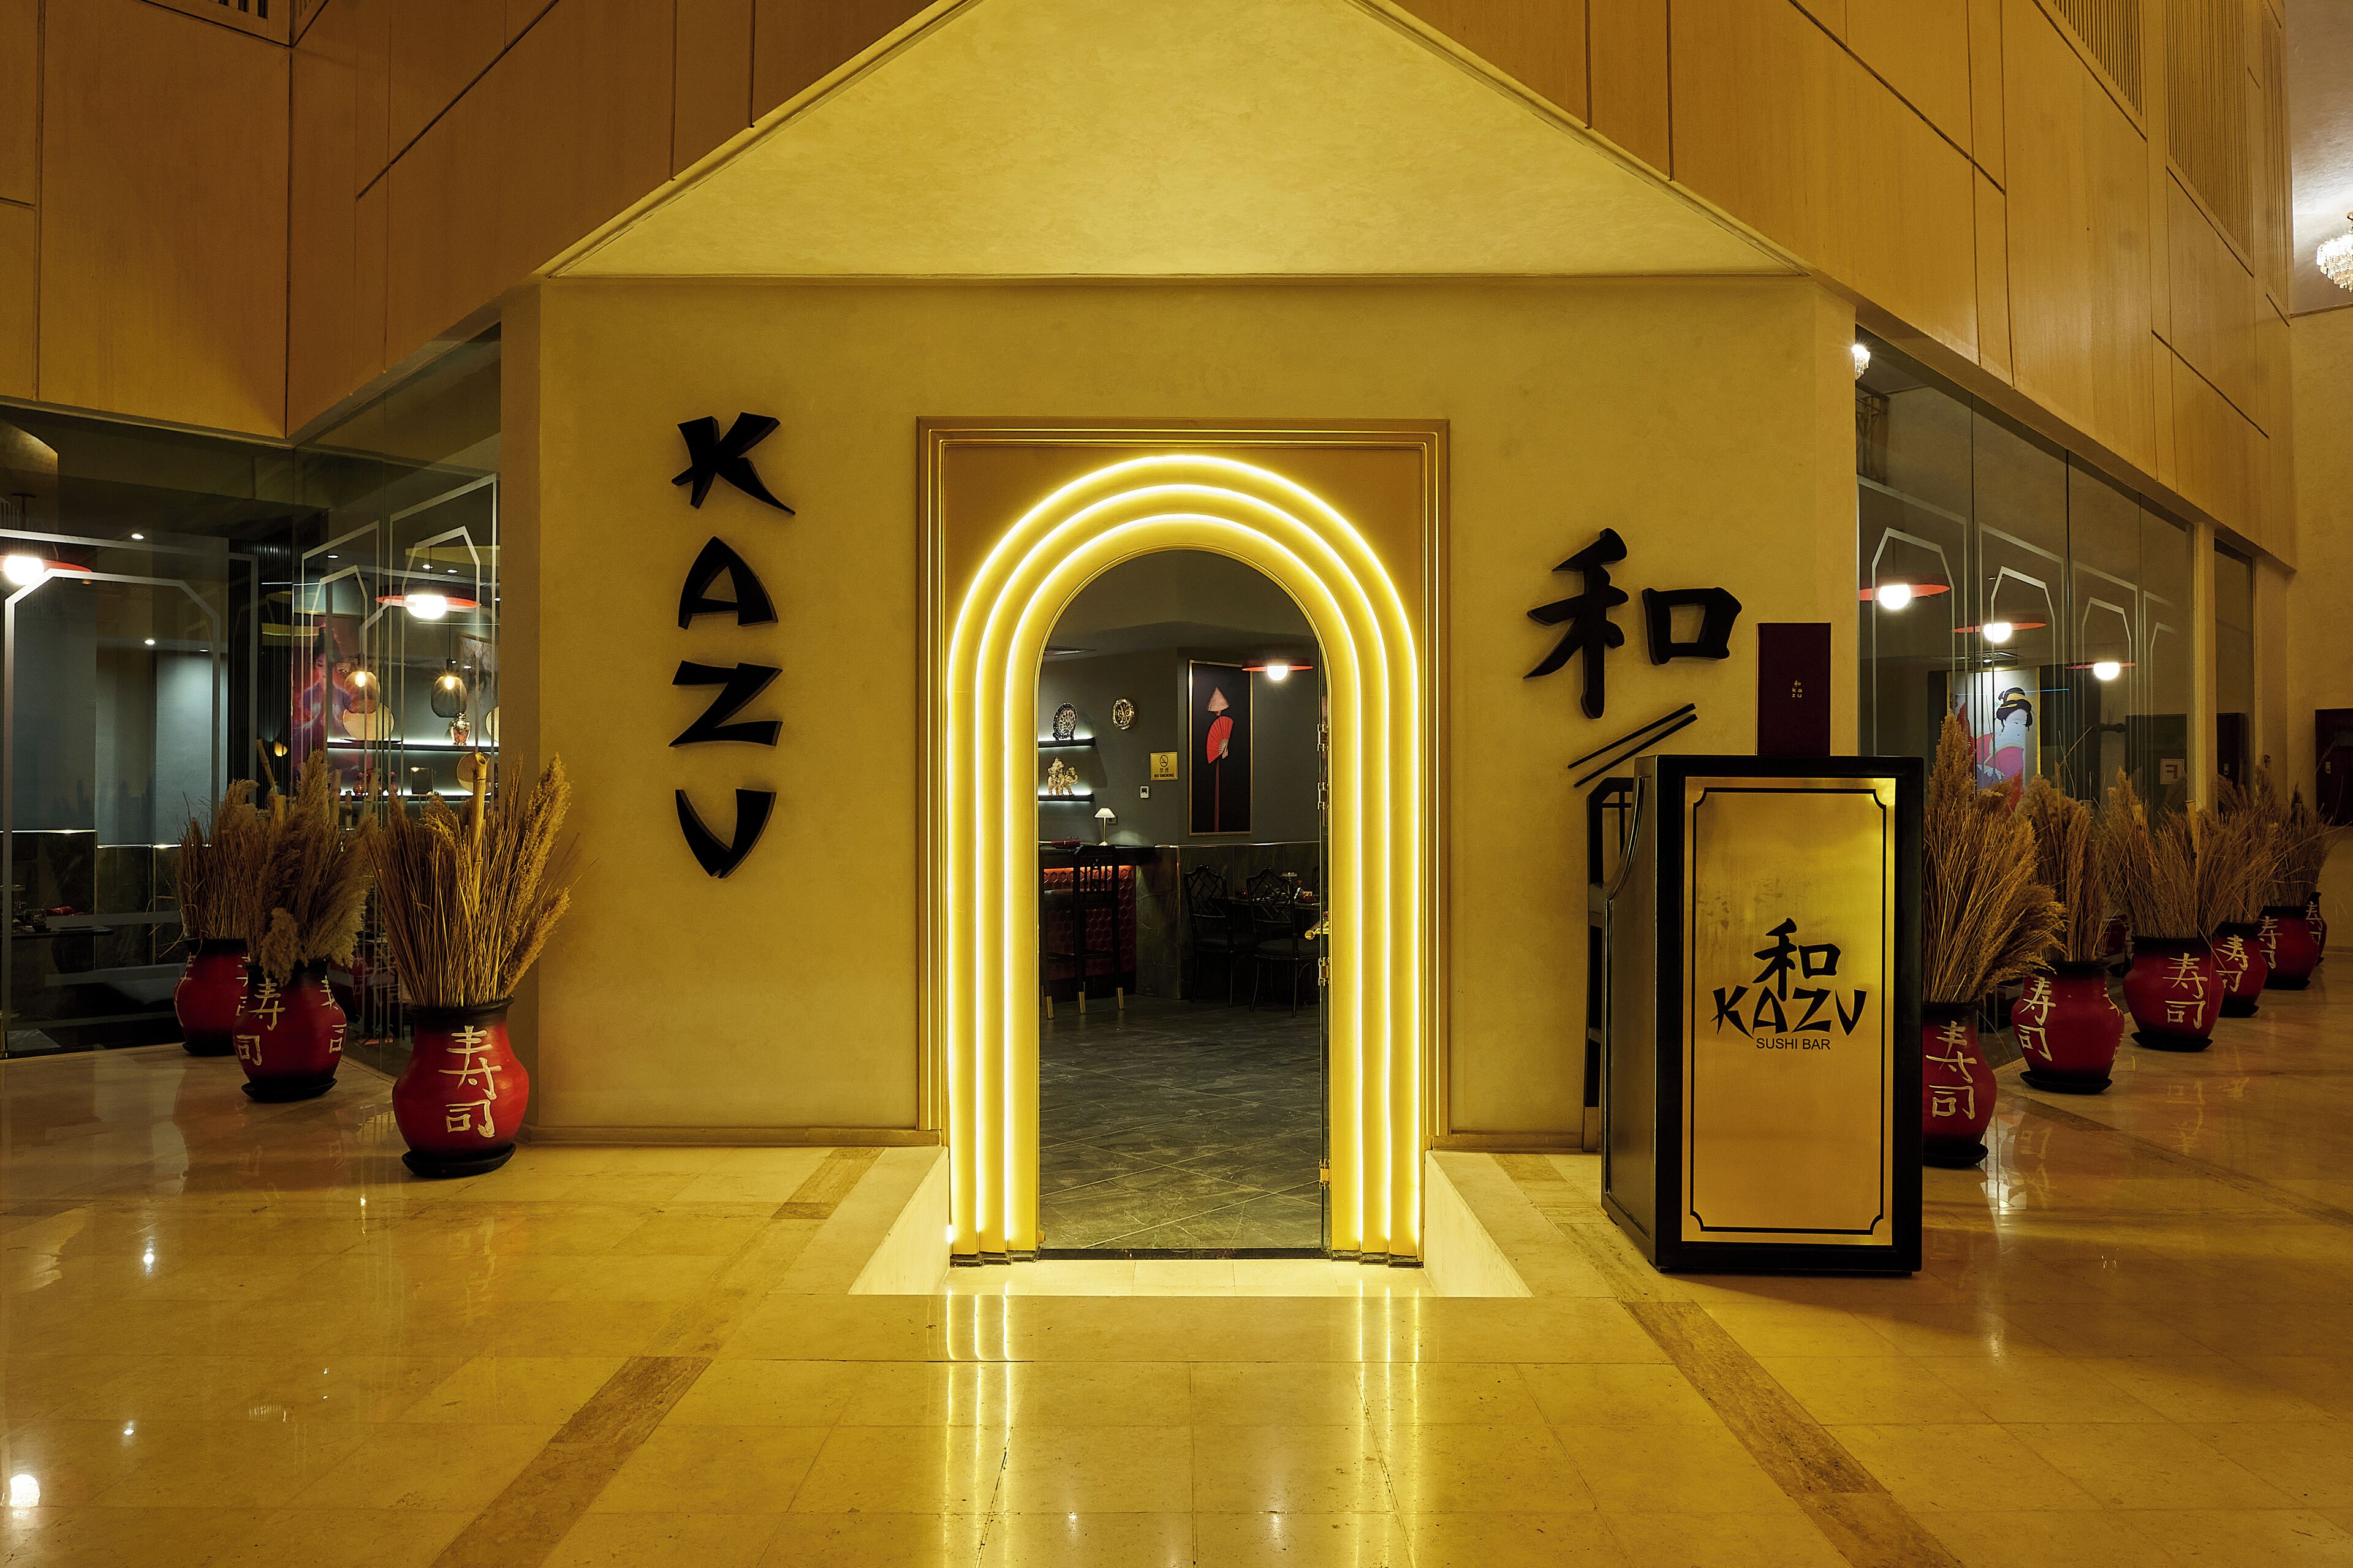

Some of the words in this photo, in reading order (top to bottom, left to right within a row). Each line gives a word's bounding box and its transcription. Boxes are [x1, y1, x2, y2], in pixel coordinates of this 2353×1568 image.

[1523, 527, 1742, 720] 和
[1751, 917, 1841, 1002] 和
[2162, 952, 2208, 1029] 寿司
[1756, 1038, 1798, 1050] SUSHI
[1802, 1039, 1831, 1050] BAR
[2018, 977, 2056, 1061] 寿司
[438, 1025, 502, 1138] 寿司
[1925, 1020, 1977, 1119] 寿司
